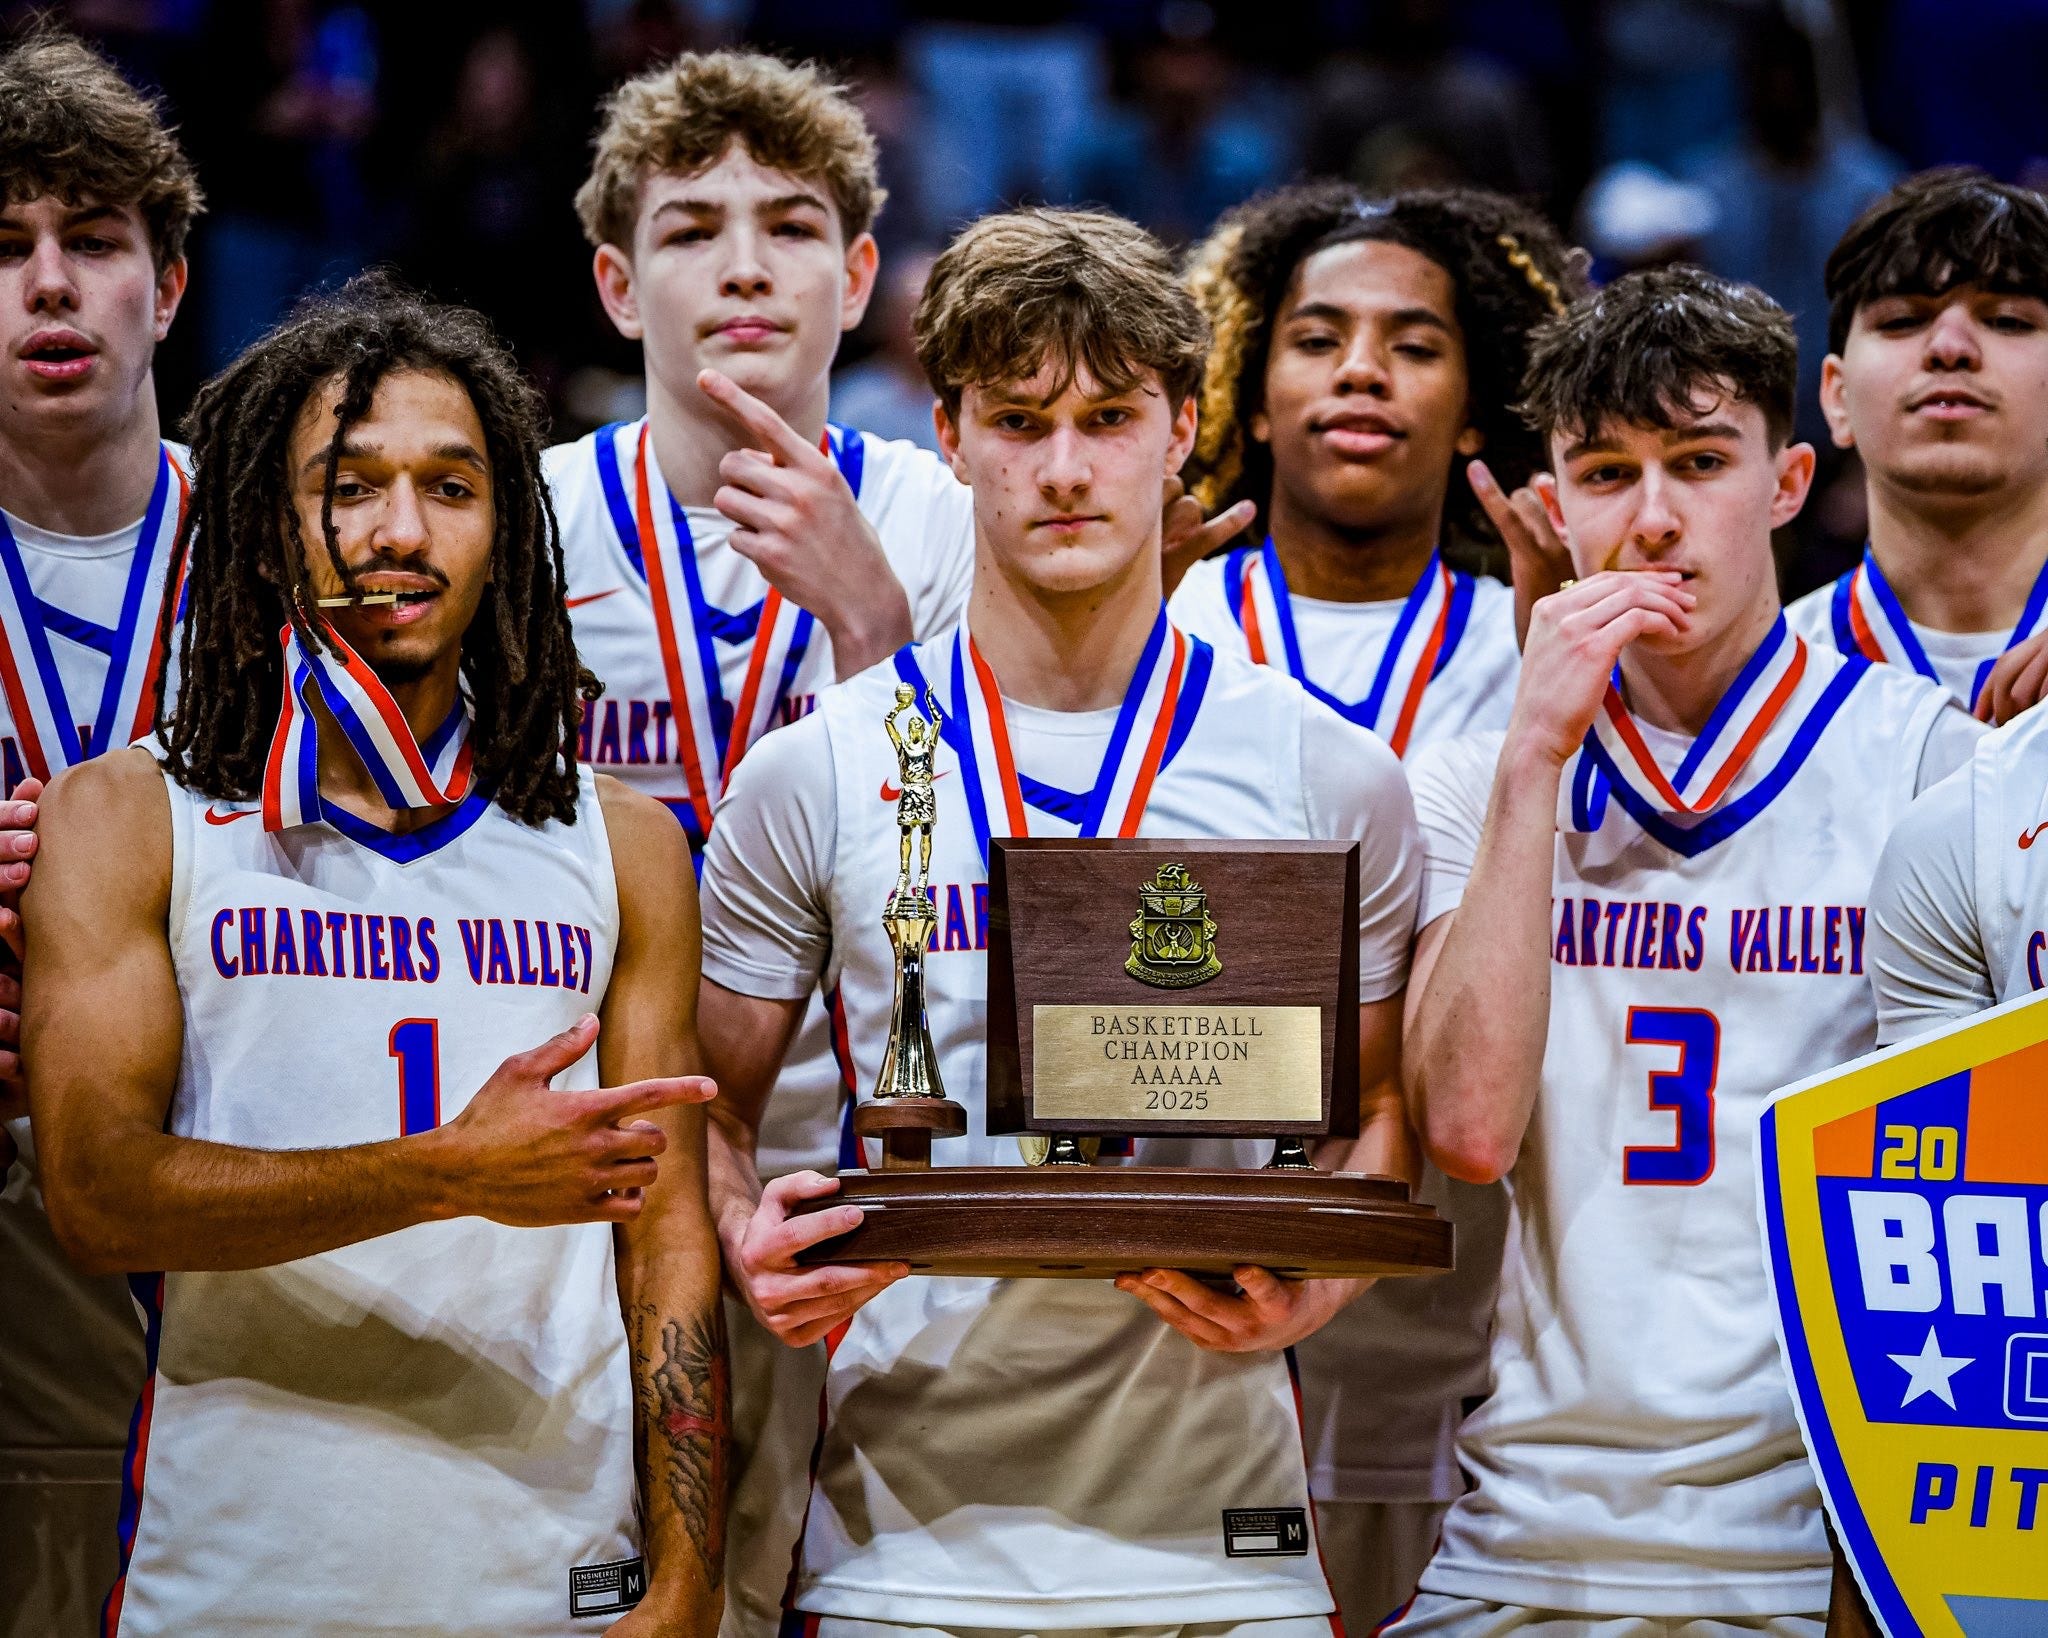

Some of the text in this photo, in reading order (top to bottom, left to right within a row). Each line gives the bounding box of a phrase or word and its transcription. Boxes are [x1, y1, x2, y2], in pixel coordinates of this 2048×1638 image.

[577, 699, 683, 764] HART
[211, 907, 593, 995] CHARTIERS VALLEY
[1551, 898, 1866, 975] ARTIERS VALLEY
[1090, 1015, 1263, 1036] BASKETBALL
[1104, 1040, 1249, 1061] CHAMPION
[388, 1017, 441, 1138] 1
[1130, 1065, 1223, 1086] AAAAA
[1145, 1090, 1209, 1110] 2025
[1623, 1005, 1721, 1186] 3
[1881, 1124, 1959, 1181] 20
[1847, 1189, 2048, 1319] BA
[1909, 1461, 2048, 1531] PIT
[1287, 1523, 1301, 1541] M
[627, 1574, 640, 1594] M
